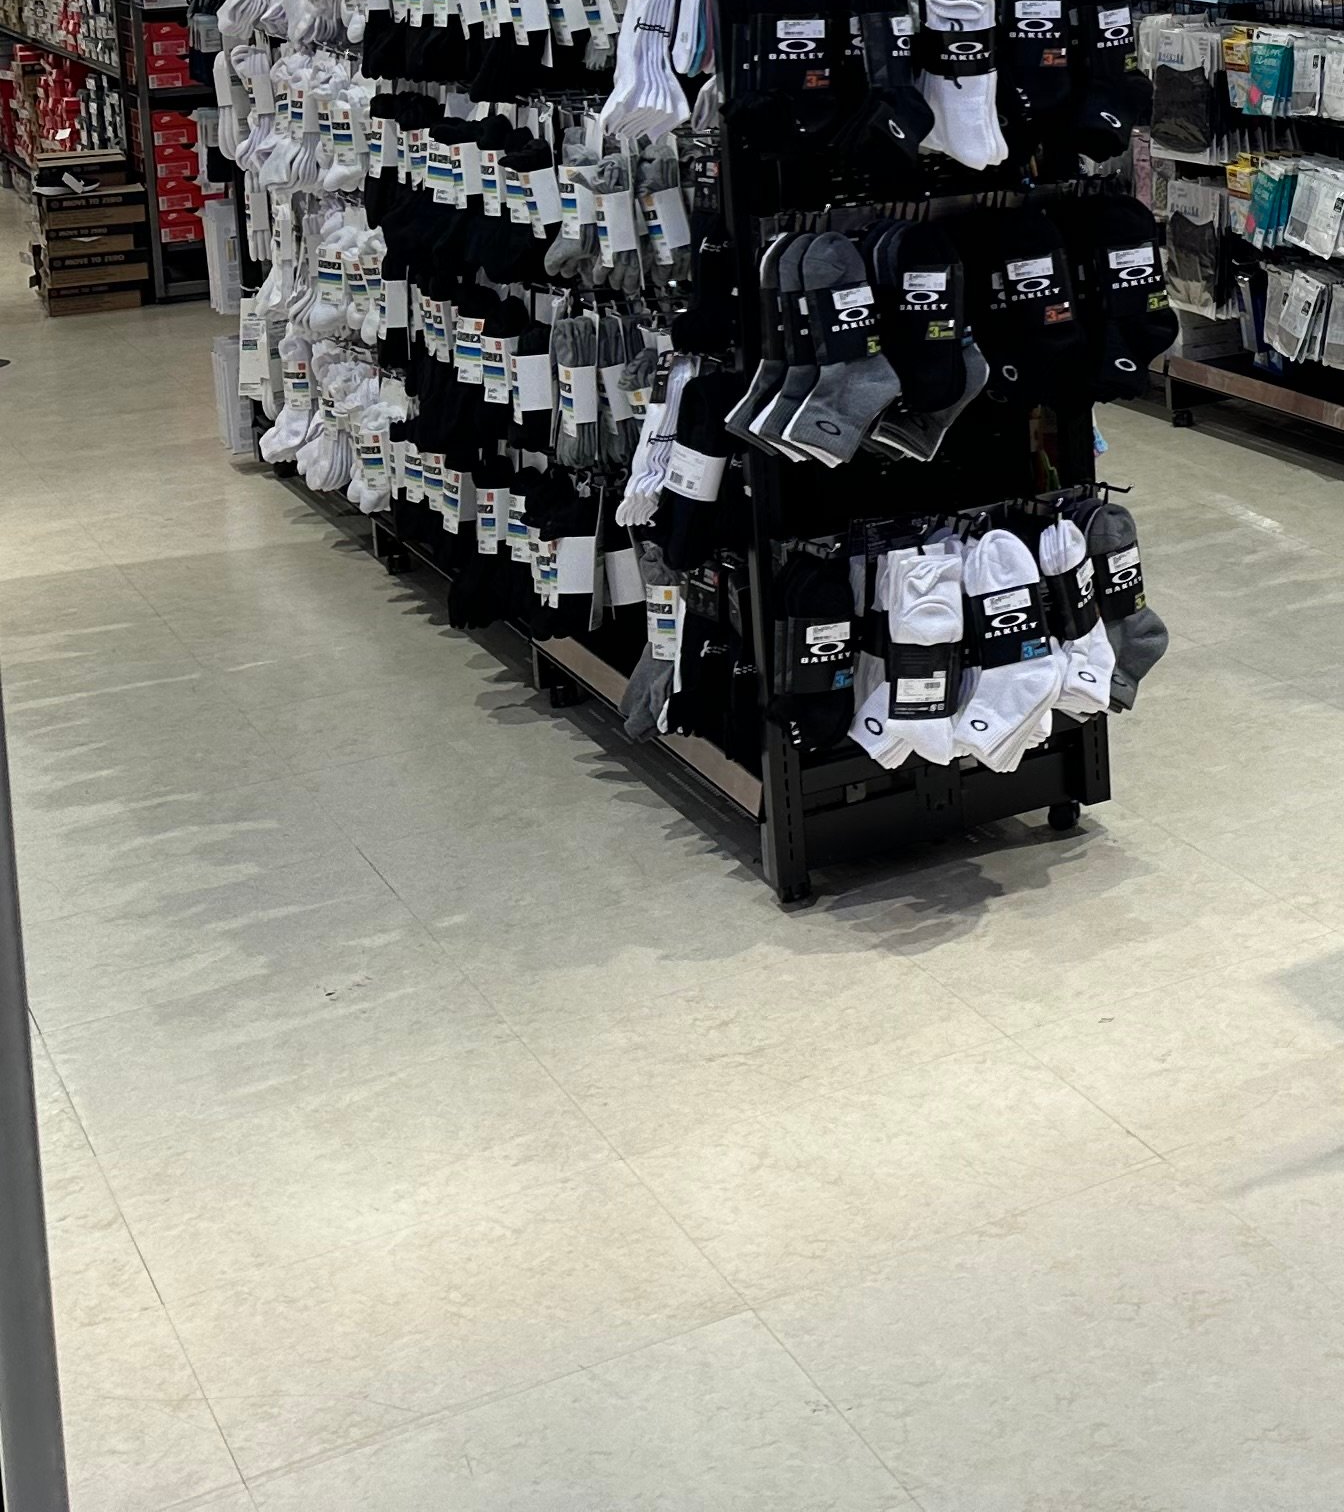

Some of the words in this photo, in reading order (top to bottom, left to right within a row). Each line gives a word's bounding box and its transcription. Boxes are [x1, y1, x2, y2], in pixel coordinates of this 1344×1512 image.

[1008, 31, 1061, 39] OAKLEY
[768, 51, 825, 60] OAKLEY
[940, 51, 992, 61] OAKLEY
[1111, 274, 1163, 290] OAKLEY
[1011, 287, 1061, 302] OAKLEY
[899, 303, 949, 311] OAKLEY
[831, 318, 876, 333] OAKLEY
[984, 621, 1038, 639] OAKLEY
[800, 649, 851, 665] OAKLEY
